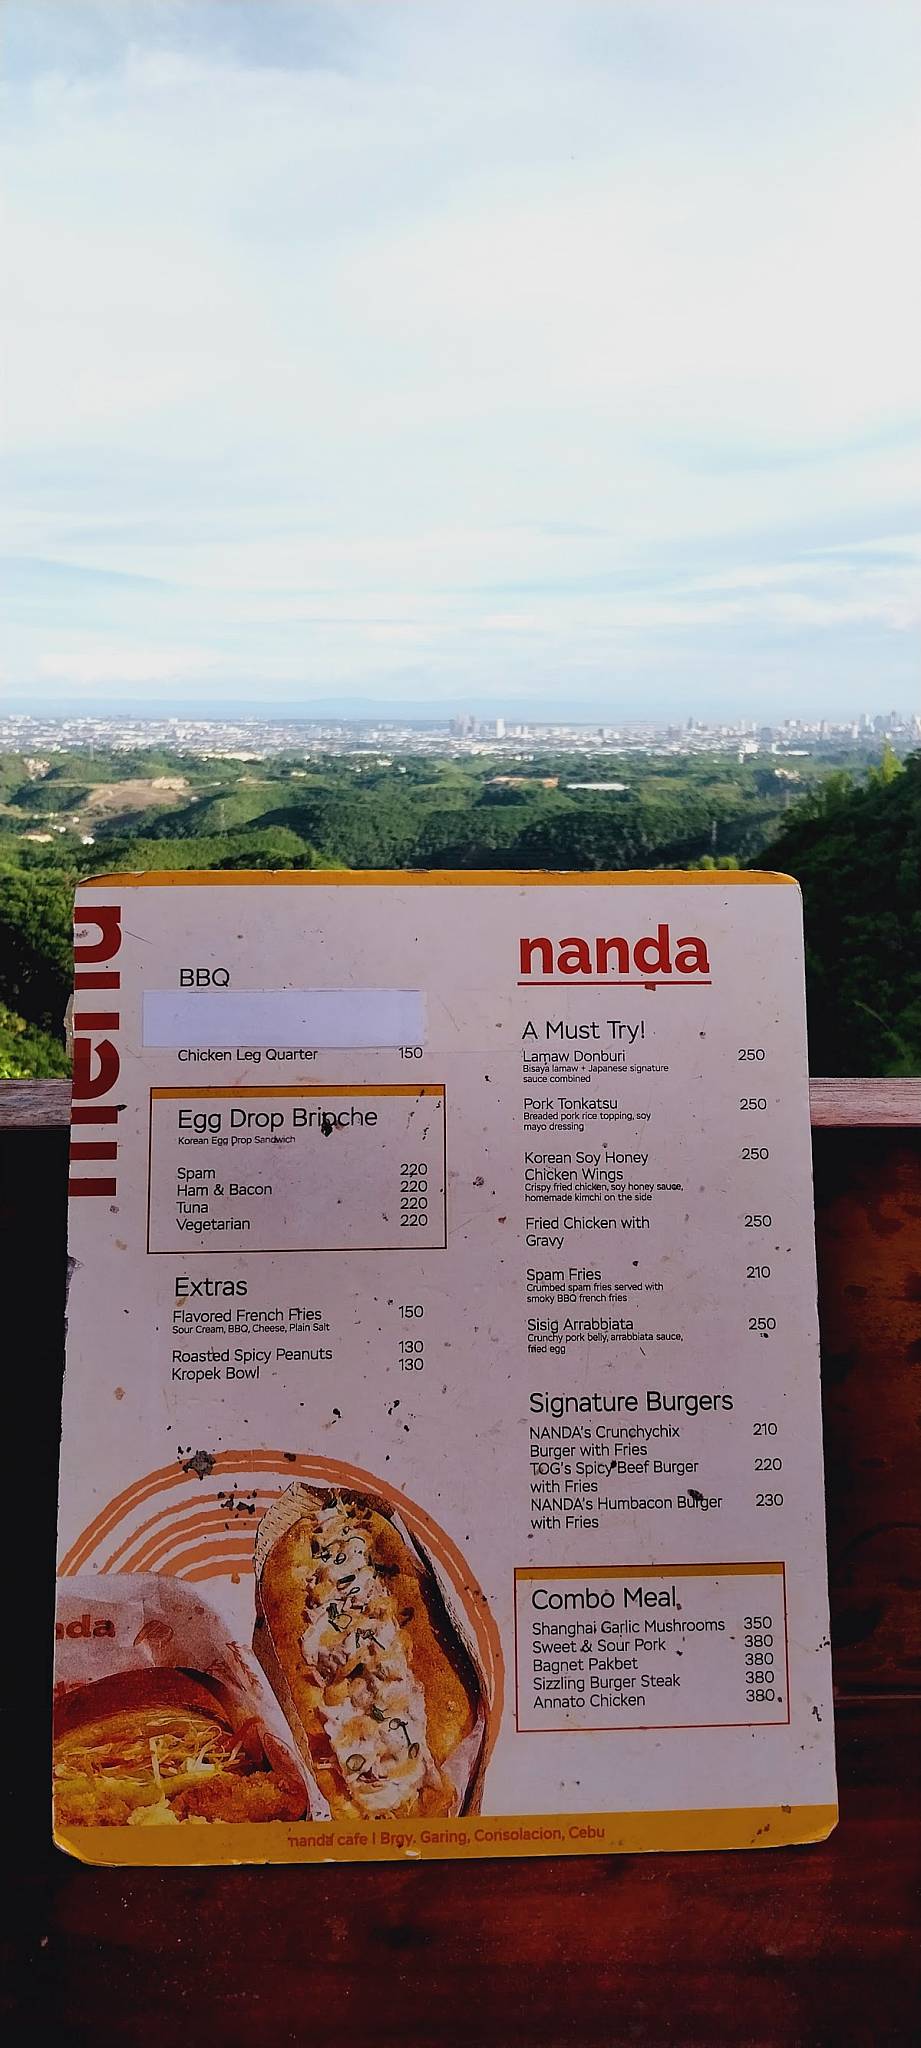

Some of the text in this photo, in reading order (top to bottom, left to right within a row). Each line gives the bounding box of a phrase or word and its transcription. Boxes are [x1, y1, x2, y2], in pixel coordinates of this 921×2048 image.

[519, 924, 709, 975] nanda
[179, 968, 230, 987] BBQ
[522, 1020, 646, 1044] A Must Try!
[177, 1048, 318, 1064] Chicken Leg Quarter
[398, 1046, 423, 1060] 150
[522, 1050, 626, 1062] Lamaw Donburi
[737, 1049, 765, 1061] 250
[522, 1064, 550, 1074] Bisaya
[552, 1064, 579, 1073] lamaw
[588, 1064, 628, 1074] Japanese
[629, 1063, 669, 1073] signature
[522, 1074, 591, 1083] sauce combined
[523, 1097, 618, 1110] Pork Tonkatsu
[739, 1098, 767, 1110] 250
[178, 1109, 222, 1133] Egg
[230, 1108, 284, 1132] Drop
[523, 1110, 651, 1122] Breaded pork rice topping, soy
[523, 1121, 585, 1133] mayo dressing
[178, 1134, 296, 1146] Korean Egg Drop Sandwich
[524, 1151, 649, 1167] Korean Soy Honey
[741, 1147, 769, 1160] 250
[177, 1167, 216, 1182] Spam
[400, 1163, 428, 1177] 220
[524, 1168, 624, 1183] Chicken Wings
[177, 1183, 273, 1196] Ham & Bacon
[400, 1180, 428, 1193] 220
[524, 1182, 684, 1193] Crispy fried chicken, soy honey sauce,
[400, 1197, 428, 1210] 220
[524, 1194, 573, 1202] homemade
[574, 1193, 602, 1202] kimchi
[618, 1193, 633, 1201] the
[634, 1193, 653, 1201] side
[176, 1201, 209, 1214] Tuna
[176, 1217, 250, 1233] Vegetarian
[400, 1214, 428, 1227] 220
[526, 1215, 650, 1230] Fried Chicken with
[744, 1214, 772, 1227] 250
[526, 1234, 564, 1249] Gravy
[526, 1267, 602, 1283] Spam Fries
[746, 1265, 771, 1278] 210
[175, 1276, 248, 1297] Extras
[526, 1282, 664, 1293] Crumbed spam fries served with
[527, 1293, 628, 1304] smoky BBQ french fries
[173, 1307, 322, 1323] Flavored French Fries
[399, 1306, 424, 1318] 150
[172, 1322, 330, 1334] Sour Cream, BBQ, Cheese, Plain Salt
[527, 1317, 634, 1333] Sisig Arrabbiata
[748, 1317, 776, 1330] 250
[527, 1332, 684, 1343] Crunchy pork belly, arrabbiata sauce,
[399, 1341, 424, 1354] 130
[527, 1345, 566, 1354] fried egg
[172, 1348, 333, 1364] Roasted Spicy Peanuts
[398, 1358, 424, 1371] 130
[171, 1366, 260, 1383] Kropek Bowl
[529, 1391, 734, 1418] Signature Burgers
[595, 1425, 680, 1440] Crunchychix
[753, 1423, 778, 1436] 210
[530, 1443, 648, 1459] Burger with Fries
[576, 1461, 612, 1477] Spicy
[617, 1460, 650, 1474] Beef
[653, 1461, 699, 1475] Burger
[754, 1458, 782, 1471] 220
[530, 1479, 598, 1493] with Fries
[598, 1496, 673, 1510] Humbacon
[677, 1494, 723, 1511] Burger
[756, 1494, 784, 1507] 230
[531, 1515, 599, 1529] with Fries
[532, 1586, 676, 1610] Combo Meal
[532, 1618, 725, 1637] Shanghai Garlic Mushrooms
[744, 1616, 772, 1629] 350
[533, 1637, 666, 1654] Sweet & Sour Pork
[744, 1634, 773, 1647] 380
[533, 1657, 638, 1675] Bagnet Pakbet
[745, 1652, 774, 1666] 380
[533, 1674, 681, 1692] Sizzling Burger Steak
[745, 1670, 774, 1684] 380
[533, 1693, 646, 1709] Annato Chicken
[746, 1688, 775, 1702] 380
[337, 1832, 368, 1846] cafe
[380, 1831, 416, 1848] Brgy.
[420, 1830, 470, 1845] Garing,
[474, 1827, 565, 1842] Consolacion,
[569, 1825, 605, 1838] Cebu
